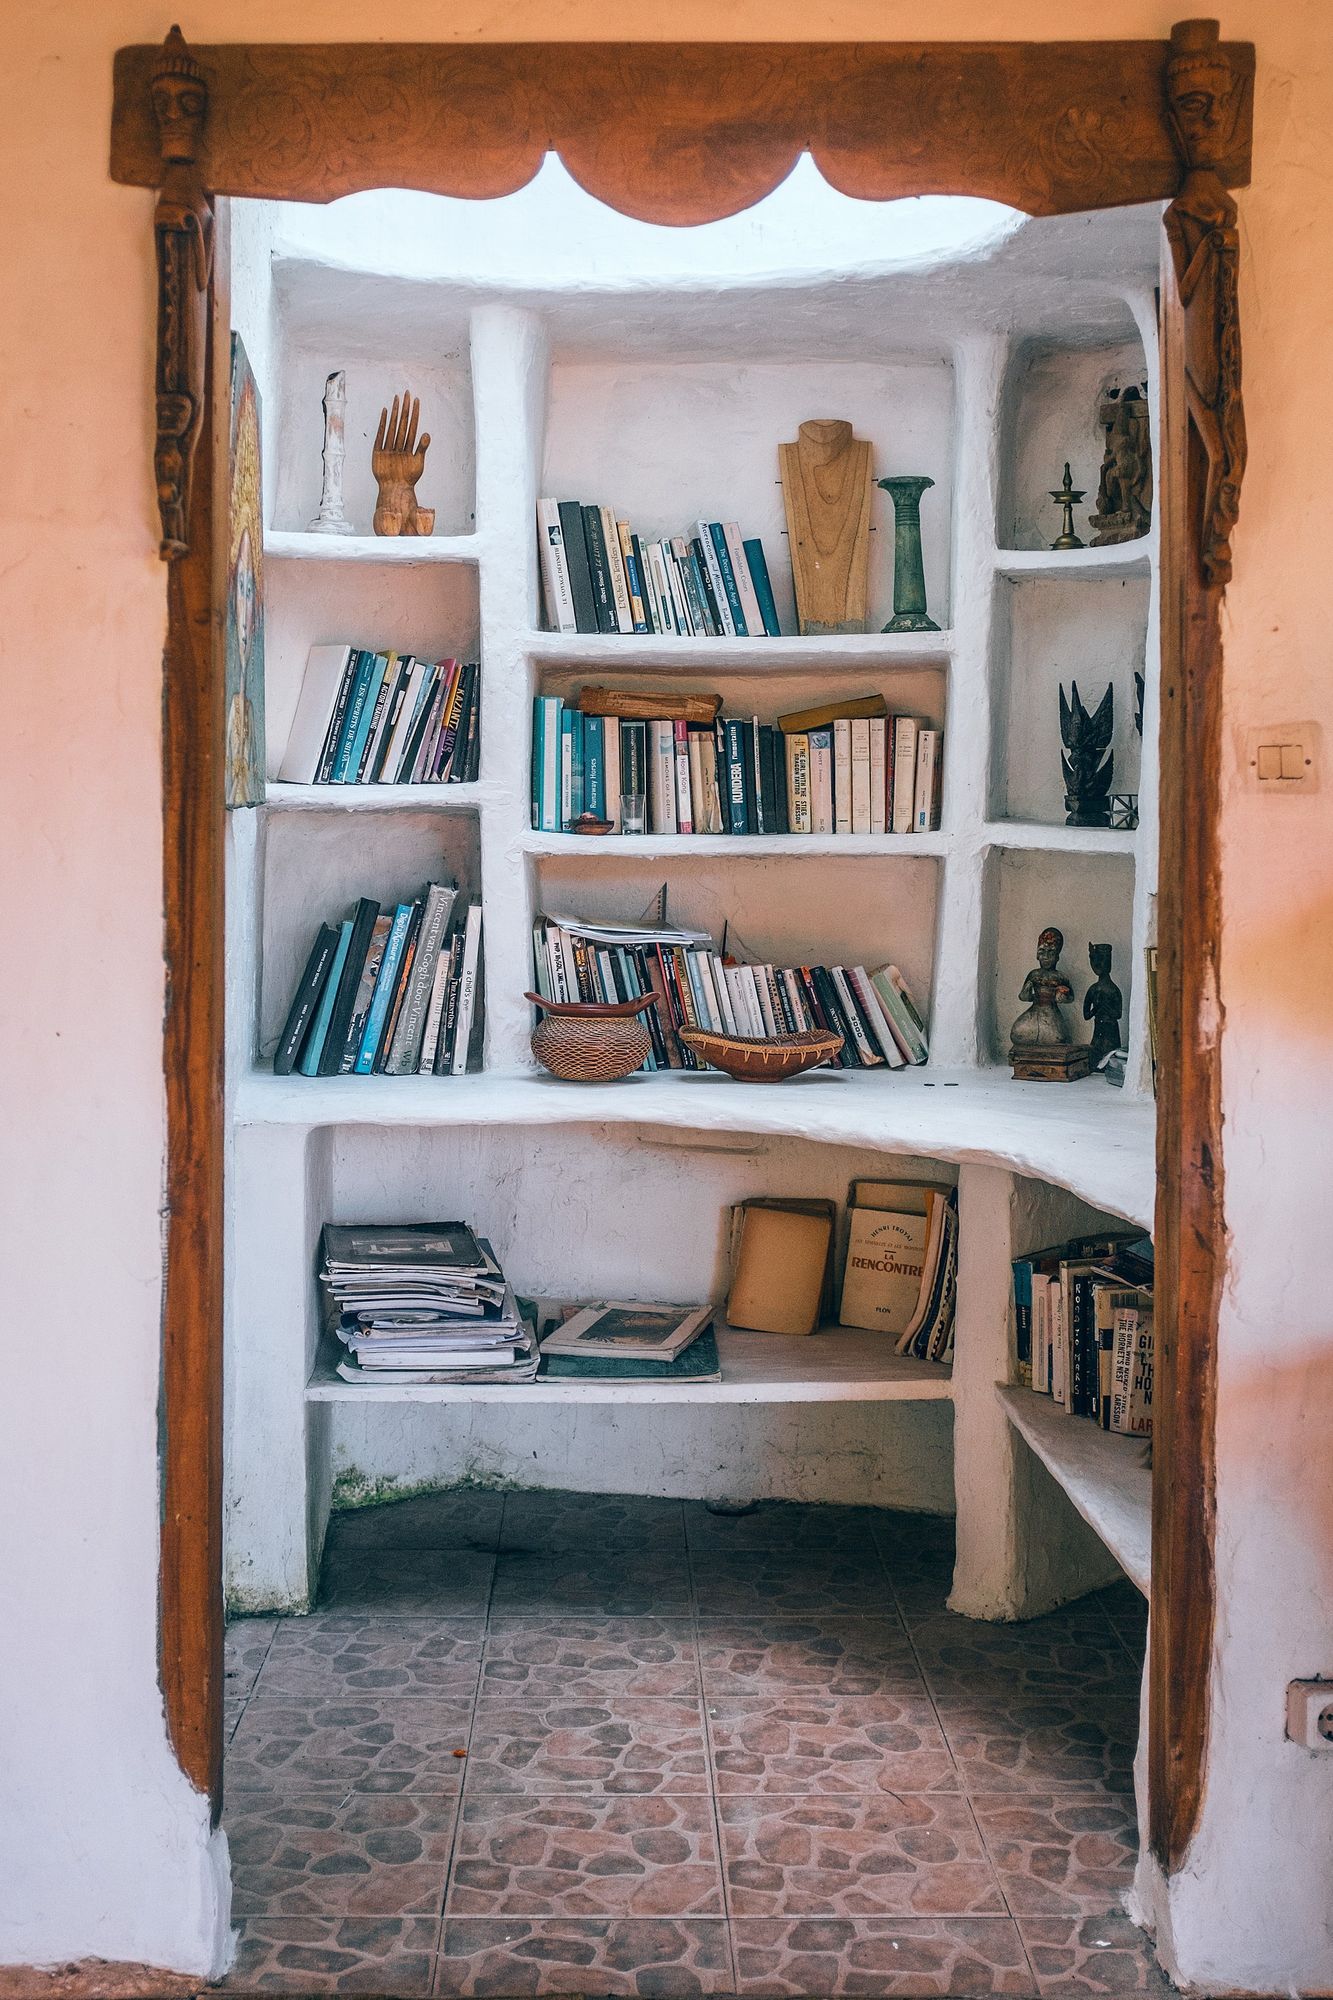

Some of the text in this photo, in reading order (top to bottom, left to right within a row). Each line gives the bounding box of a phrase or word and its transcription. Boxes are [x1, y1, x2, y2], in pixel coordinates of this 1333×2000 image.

[610, 546, 620, 573] Templiers
[733, 547, 749, 592] Forbidden Colors
[557, 574, 566, 596] VOYAGE
[720, 558, 730, 574] Decay
[728, 591, 738, 607] Angel
[377, 684, 388, 704] ACTOR
[341, 682, 366, 762] LES SECRETS DE SHIVA
[370, 703, 383, 730] TRAINING
[442, 687, 464, 752] KAZANTZAKIS
[730, 762, 742, 803] KUNDERA
[435, 895, 448, 935] Vincent
[389, 912, 408, 961] DigitalXposure
[425, 934, 436, 951] van
[416, 952, 433, 980] Gogh
[553, 954, 562, 971] MySQL,
[413, 981, 427, 1005] door
[464, 976, 475, 997] child's
[462, 998, 470, 1011] eye
[406, 1005, 421, 1045] Vincent
[850, 1015, 862, 1038] 3000
[400, 1049, 411, 1066] Wb
[871, 1225, 913, 1242] HENRI TROYAT
[852, 1257, 924, 1276] RENCONTRE
[1116, 1332, 1125, 1364] HORNET'S
[1139, 1335, 1154, 1349] GI
[1115, 1366, 1123, 1382] NEST
[1112, 1393, 1121, 1423] LARSSON
